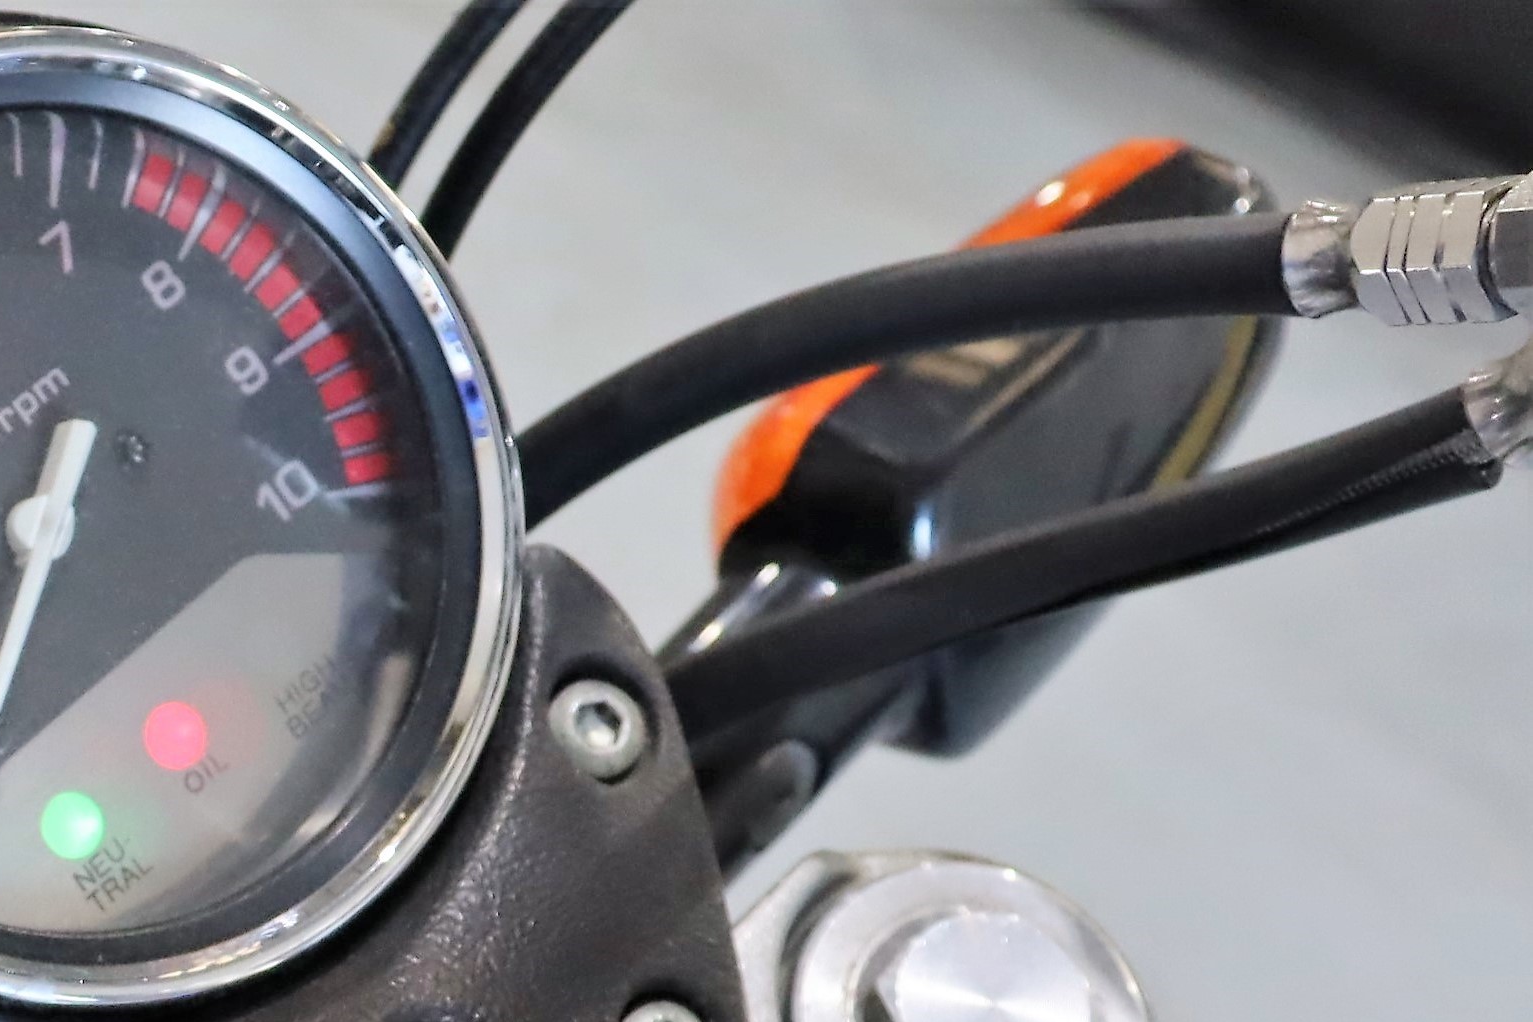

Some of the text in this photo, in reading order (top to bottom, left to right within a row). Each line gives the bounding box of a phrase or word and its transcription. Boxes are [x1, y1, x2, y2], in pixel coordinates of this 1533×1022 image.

[37, 219, 75, 275] 7
[139, 260, 187, 310] 8
[223, 345, 269, 395] 9
[255, 460, 319, 522] 10
[184, 754, 229, 794] OIL
[85, 858, 154, 912] TRAL
